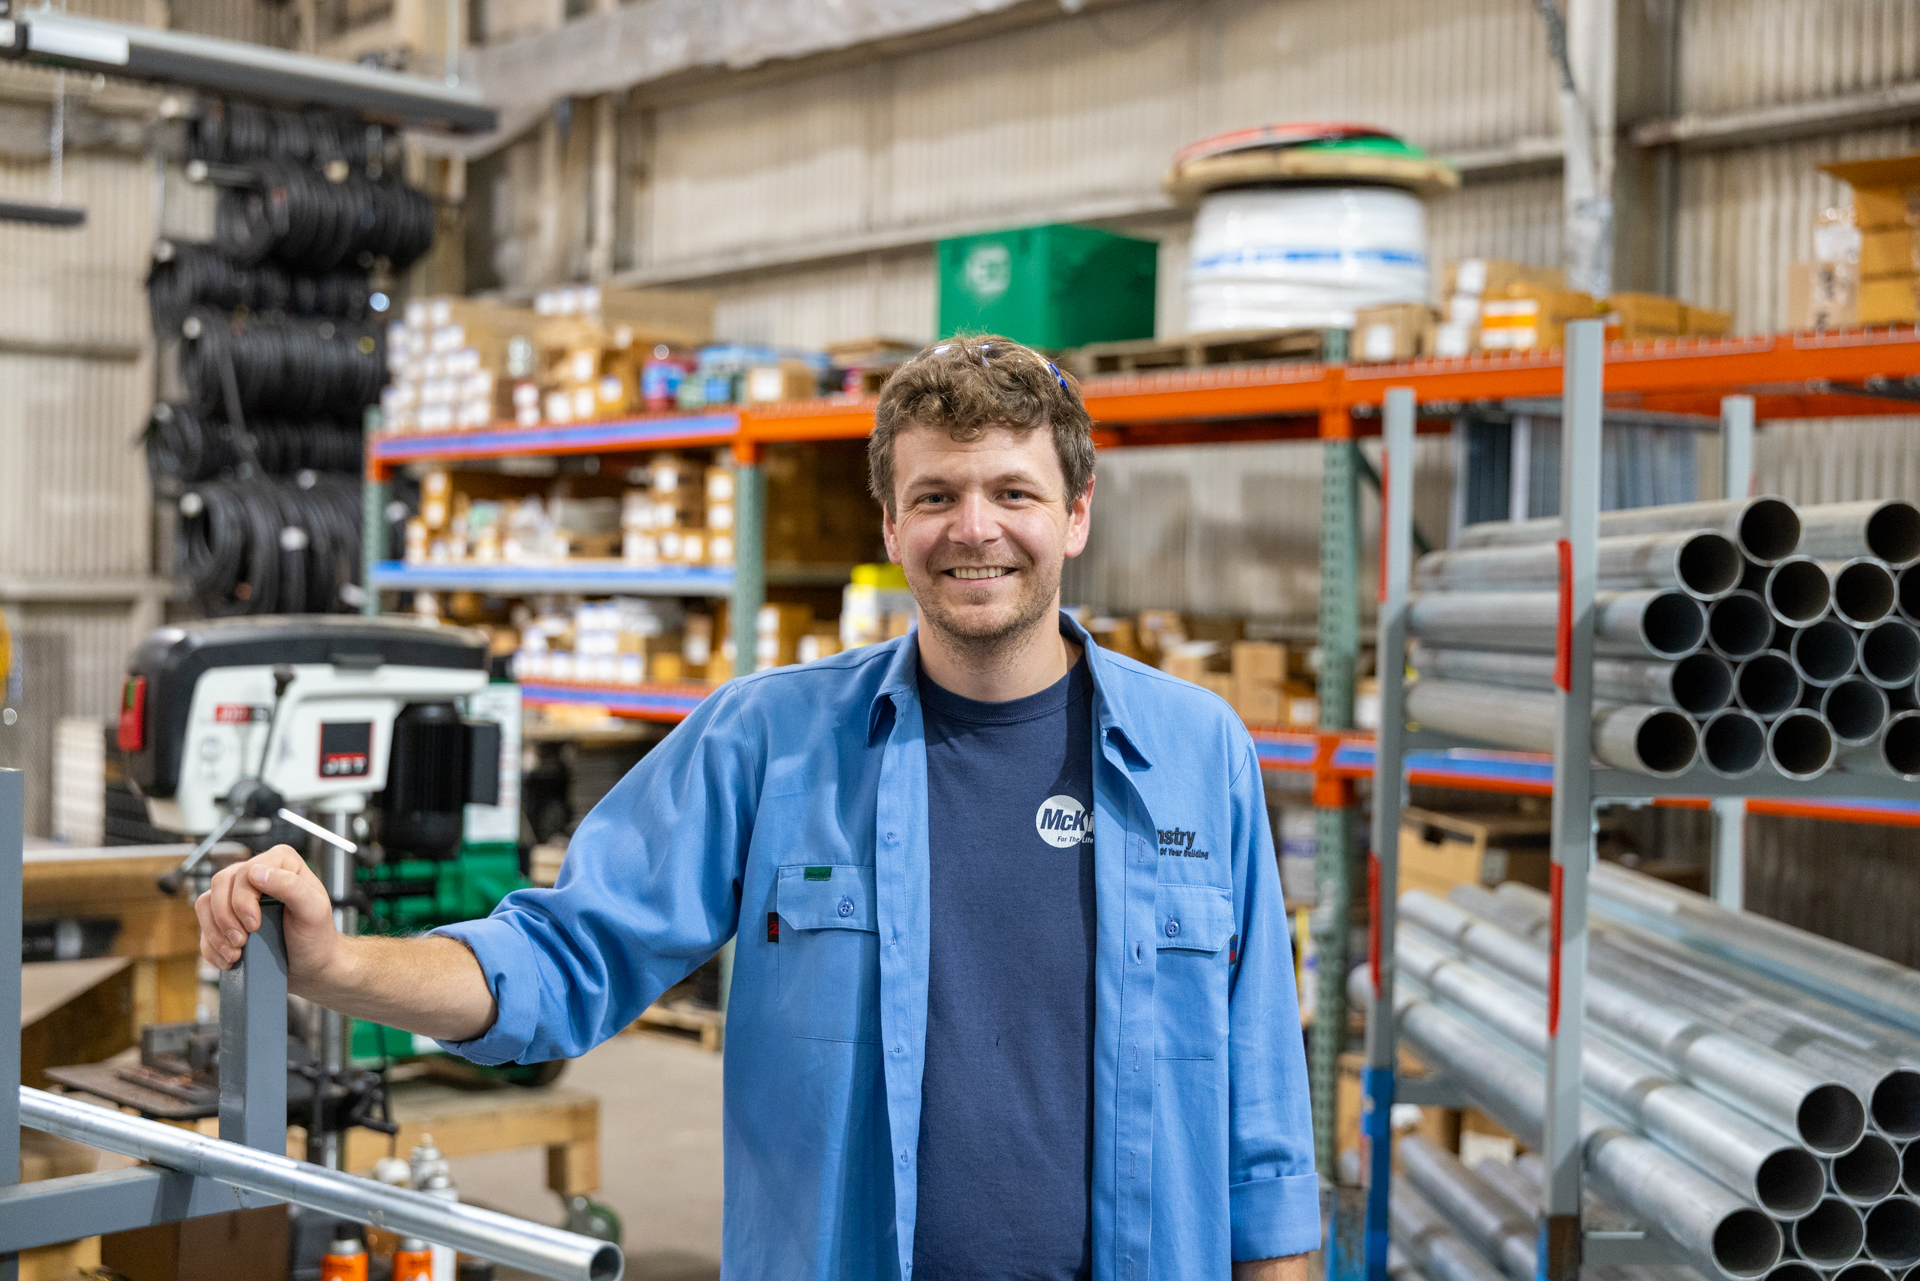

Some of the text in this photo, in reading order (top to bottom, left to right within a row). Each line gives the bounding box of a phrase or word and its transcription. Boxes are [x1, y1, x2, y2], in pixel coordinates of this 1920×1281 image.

[1040, 808, 1095, 833] McKi
[1184, 849, 1209, 860] Building
[769, 923, 779, 934] 2
